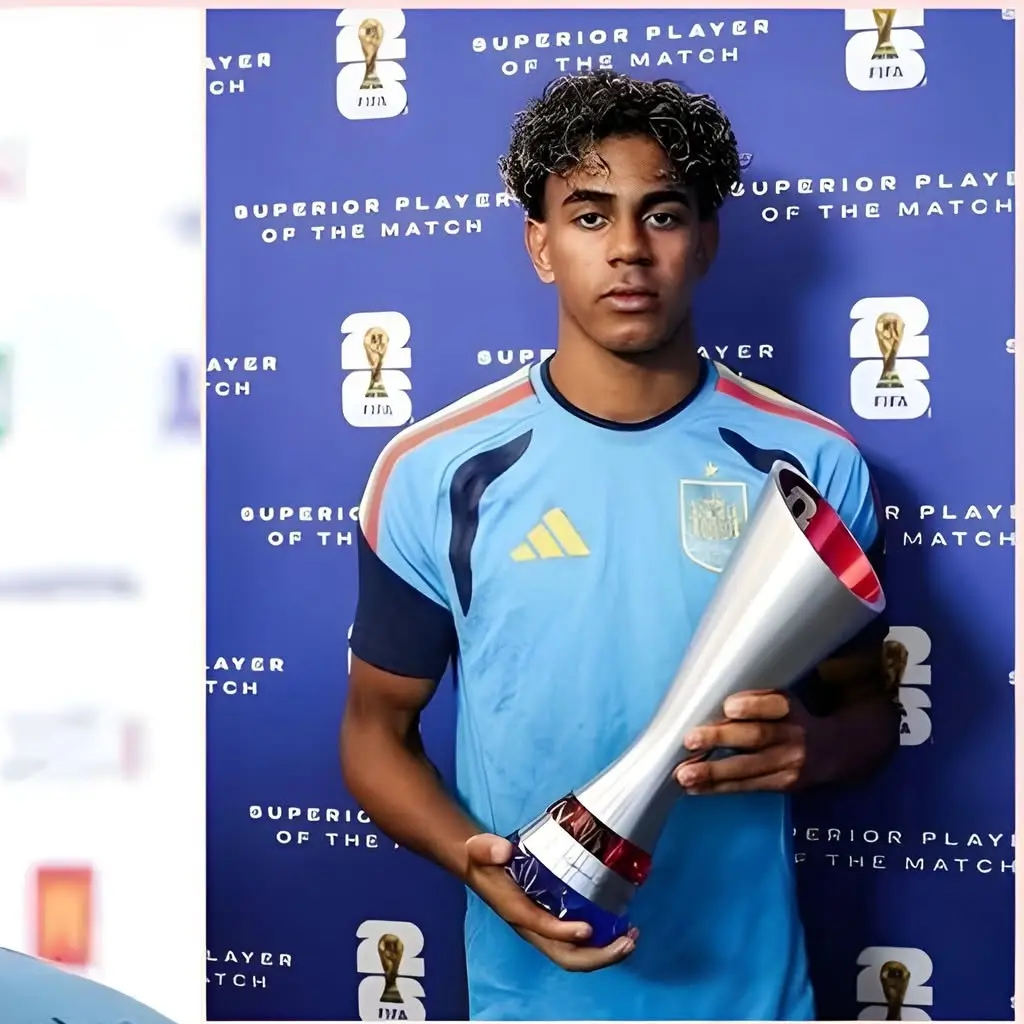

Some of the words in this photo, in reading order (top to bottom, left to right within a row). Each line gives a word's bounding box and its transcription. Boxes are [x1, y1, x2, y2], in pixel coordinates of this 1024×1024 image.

[472, 28, 629, 53] SUPERIOR
[646, 19, 769, 41] PLAYER
[501, 58, 538, 76] OF
[555, 54, 614, 72] THE
[630, 47, 738, 68] MATCH
[234, 198, 380, 220] SUPERIOR
[395, 192, 510, 212] PLAYER
[761, 205, 800, 222] OF
[818, 202, 881, 219] THE
[898, 198, 1012, 217] MATCH
[261, 227, 296, 244] OF
[310, 223, 366, 241] THE
[380, 218, 482, 238] MATCH
[267, 531, 302, 546] OF
[316, 531, 353, 546] TH
[903, 531, 1016, 547] MATCH
[276, 830, 311, 845] OF
[325, 832, 379, 849] THE
[825, 854, 887, 869] THE
[904, 856, 1016, 874] MATCH
[206, 972, 267, 988] TCH
